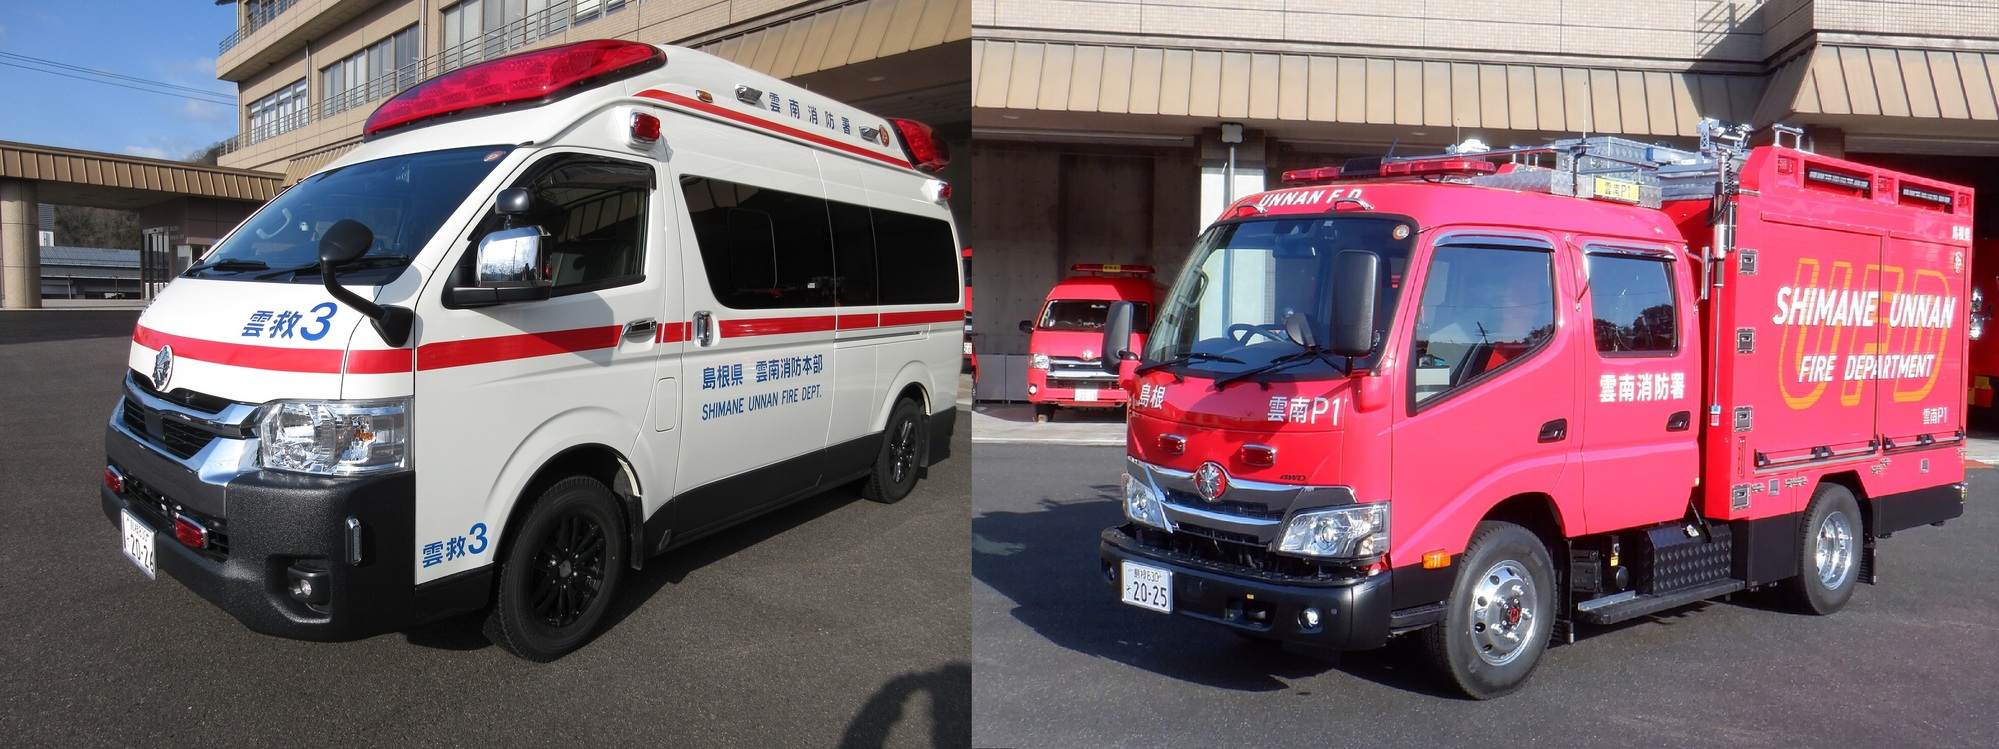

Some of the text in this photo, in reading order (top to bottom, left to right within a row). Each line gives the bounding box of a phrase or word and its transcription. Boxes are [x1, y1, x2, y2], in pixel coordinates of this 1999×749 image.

[769, 91, 851, 135] 雲南消防署
[1259, 190, 1326, 207] UNNAN
[241, 301, 338, 341] 雲救3
[1772, 286, 1957, 328] SHIMANE UNNAN
[702, 353, 823, 390] 島根県 雲南消防本部
[1798, 353, 1936, 382] FIRE DEPARTMENT
[702, 384, 822, 421] SHIMANE UNNAN FIRE DEPT.
[1136, 382, 1166, 409] 島根
[1599, 372, 1685, 403] 雲南消防署
[1267, 396, 1341, 427] 雲南P1
[1922, 406, 1947, 425] 雲南P1
[422, 522, 488, 568] 雲救3
